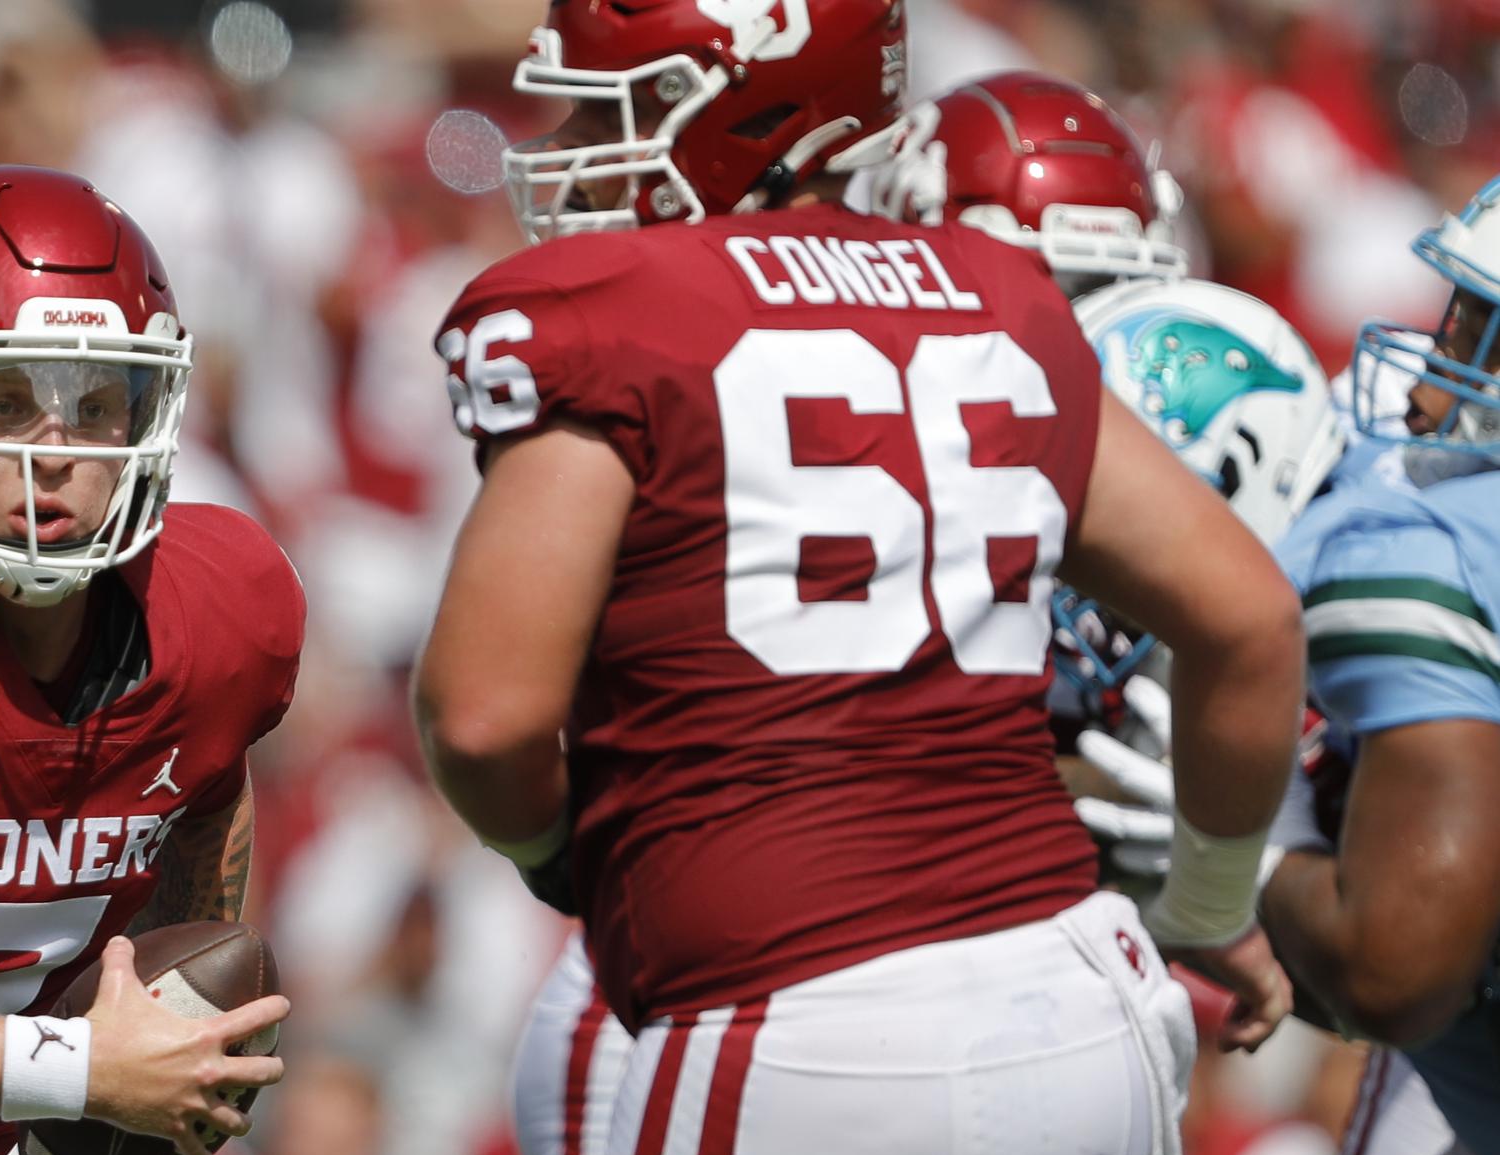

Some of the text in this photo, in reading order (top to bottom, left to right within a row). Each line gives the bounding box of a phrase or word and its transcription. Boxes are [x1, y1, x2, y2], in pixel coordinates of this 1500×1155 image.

[725, 236, 982, 310] CONGEL
[43, 310, 108, 328] OKLAHOMA
[713, 328, 1068, 676] 66
